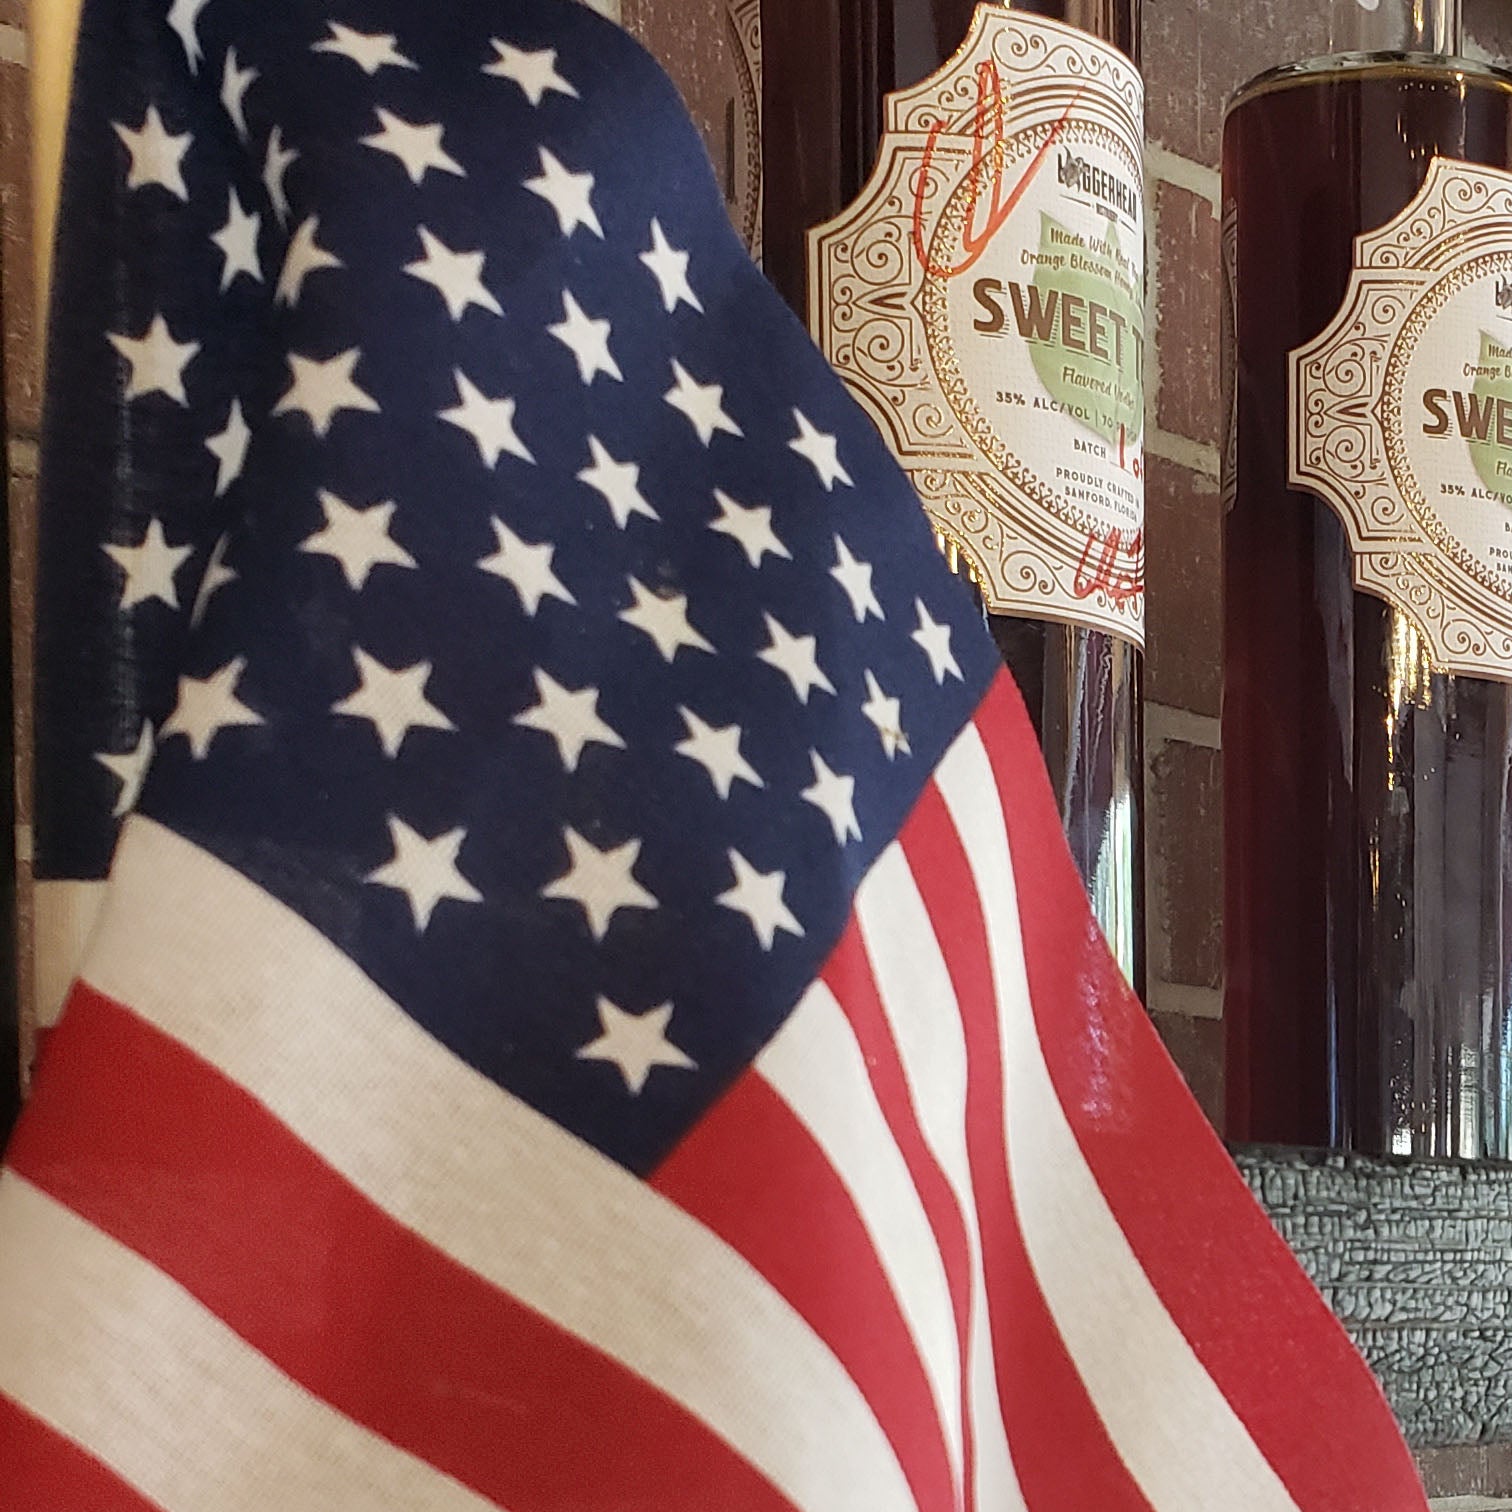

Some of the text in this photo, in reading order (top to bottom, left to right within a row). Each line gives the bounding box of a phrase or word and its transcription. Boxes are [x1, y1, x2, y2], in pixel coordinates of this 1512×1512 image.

[1057, 147, 1138, 223] LGGERHEAD
[1050, 227, 1085, 248] Made
[1089, 235, 1112, 257] With
[1021, 250, 1066, 271] Orange
[1070, 254, 1112, 281] Blossom
[973, 277, 1126, 366] SWEET
[1063, 366, 1112, 396] Flavored
[1463, 362, 1501, 380] Orange
[996, 391, 1026, 406] 35%
[1033, 397, 1090, 420] ALC/VOL
[1102, 415, 1113, 428] 70
[1074, 439, 1107, 458] BATCH
[1056, 467, 1103, 488] PROUDLY
[1107, 481, 1135, 504] CRAFTED
[1440, 483, 1465, 496] 35%
[1114, 502, 1137, 523] FLORIDA
